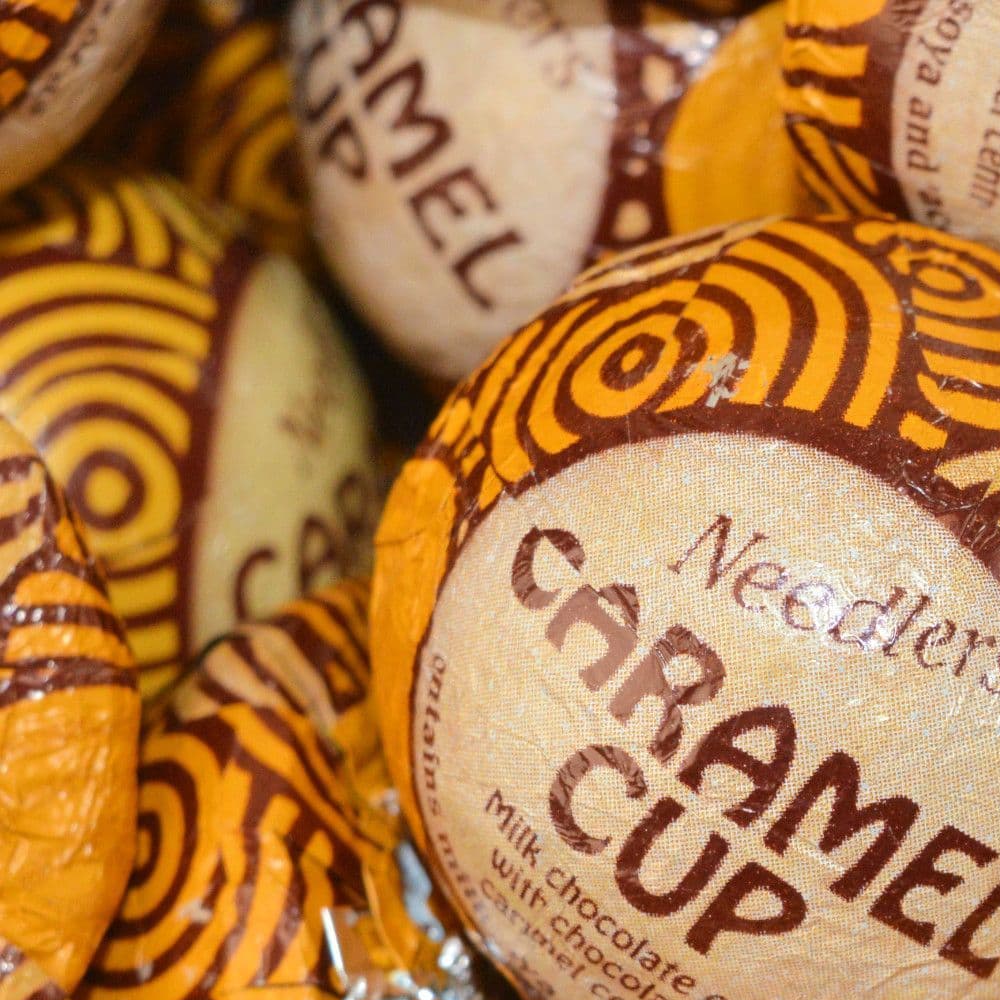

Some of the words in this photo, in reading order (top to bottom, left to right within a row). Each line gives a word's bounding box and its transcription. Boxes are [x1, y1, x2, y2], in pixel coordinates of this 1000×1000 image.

[906, 97, 940, 173] and
[485, 788, 542, 867] Milk
[545, 865, 697, 995] chocolate
[548, 743, 810, 956] CUP
